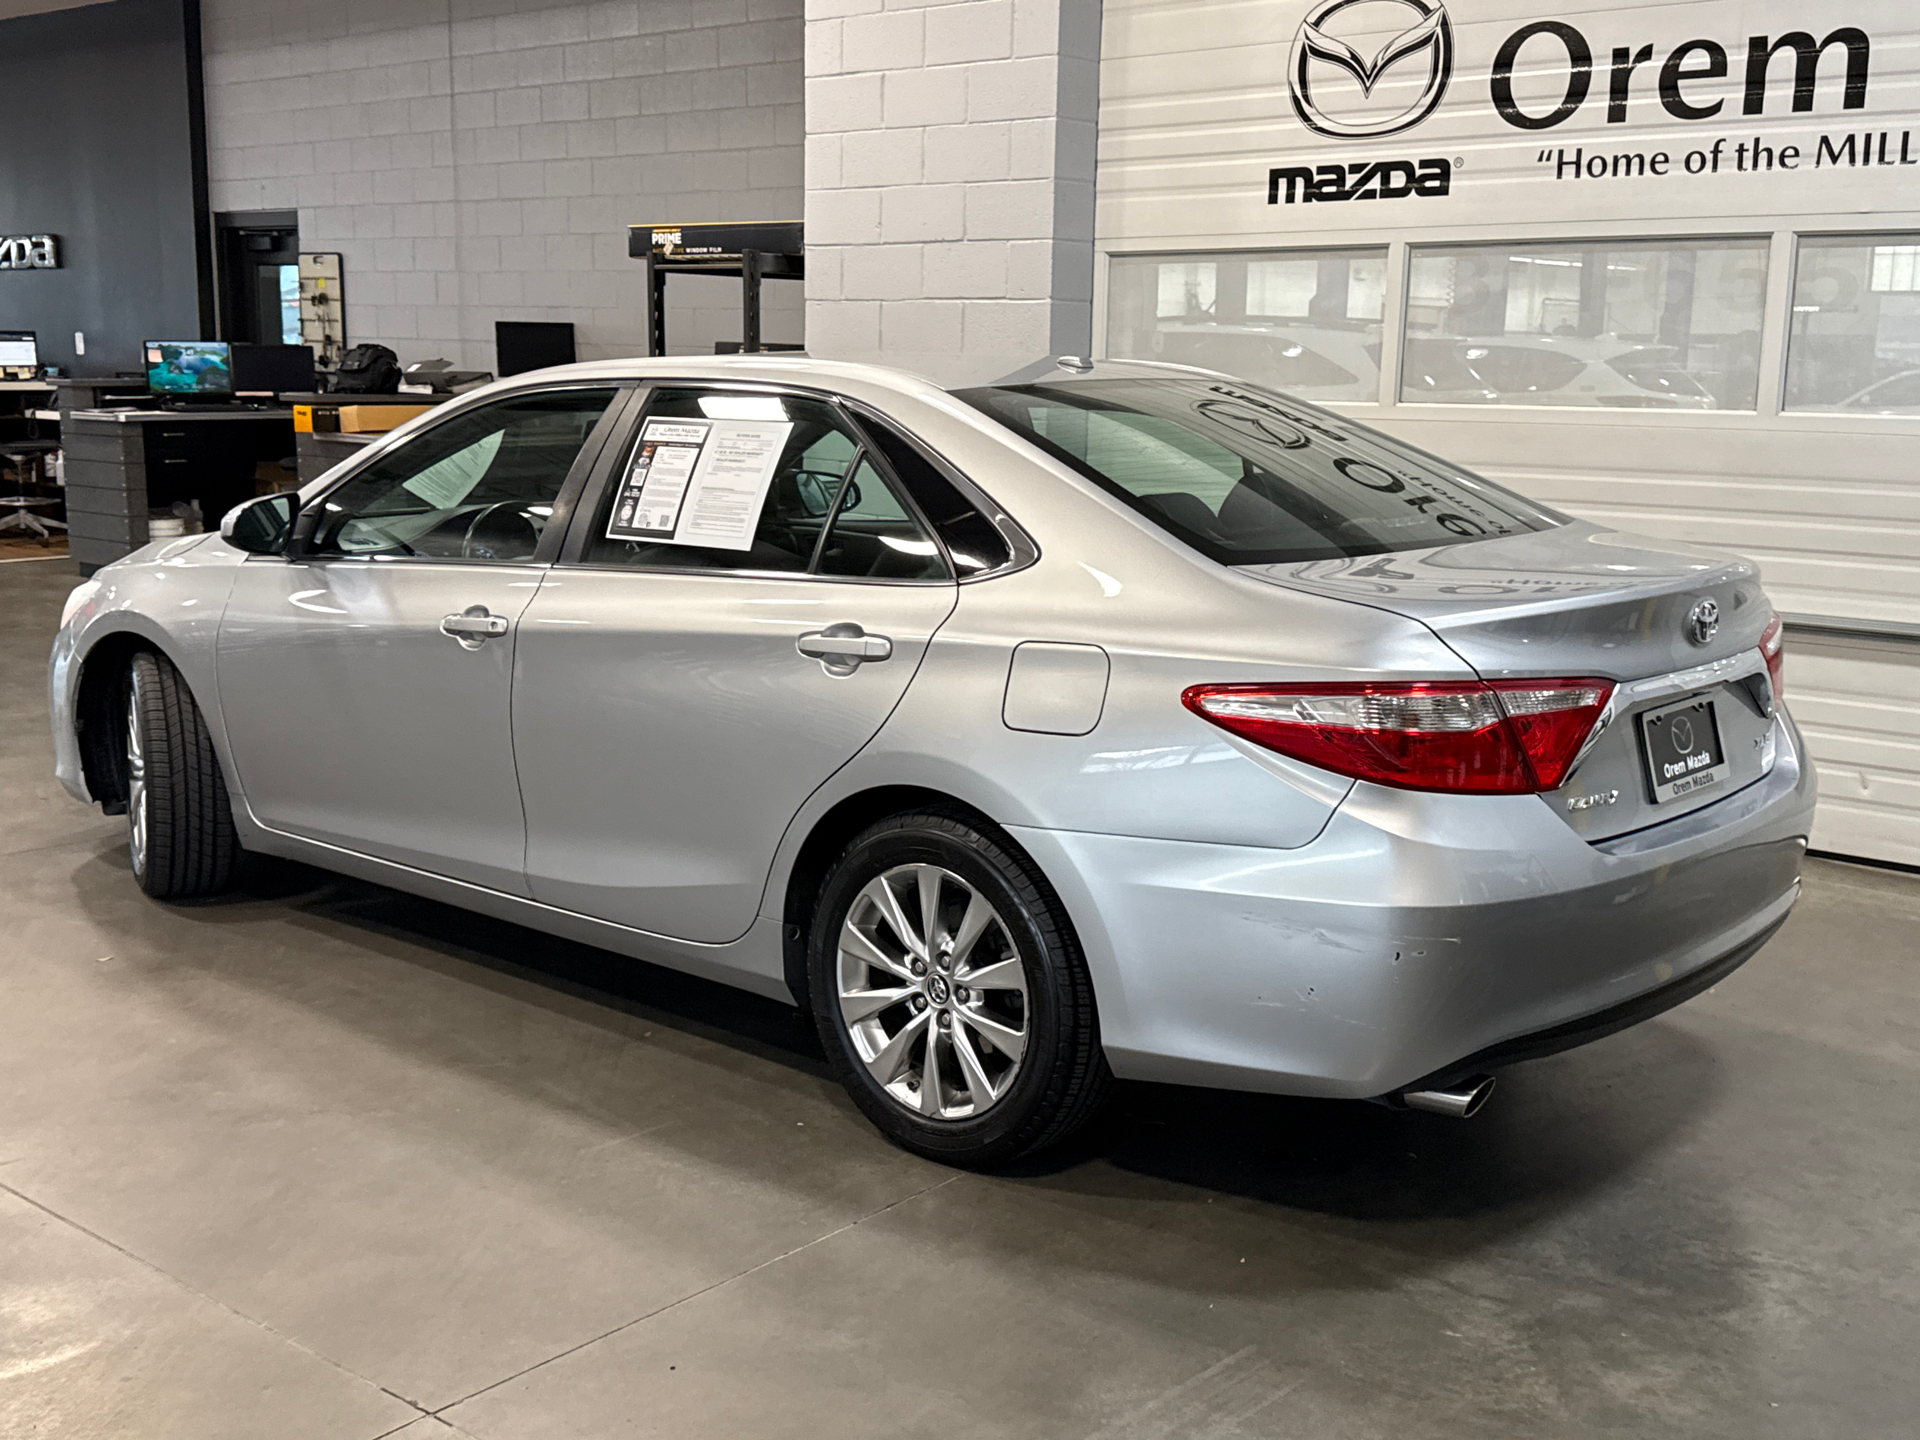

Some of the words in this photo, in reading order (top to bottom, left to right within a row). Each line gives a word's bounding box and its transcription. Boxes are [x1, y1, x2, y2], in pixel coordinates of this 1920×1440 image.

[1490, 20, 1870, 130] Orem
[1684, 138, 1727, 174] of
[1735, 136, 1800, 172] the
[652, 232, 682, 245] PRIME
[1663, 761, 1687, 779] Orem
[1686, 750, 1711, 771] Mazda
[1672, 780, 1692, 795] Orem
[1692, 771, 1714, 788] Mazda
